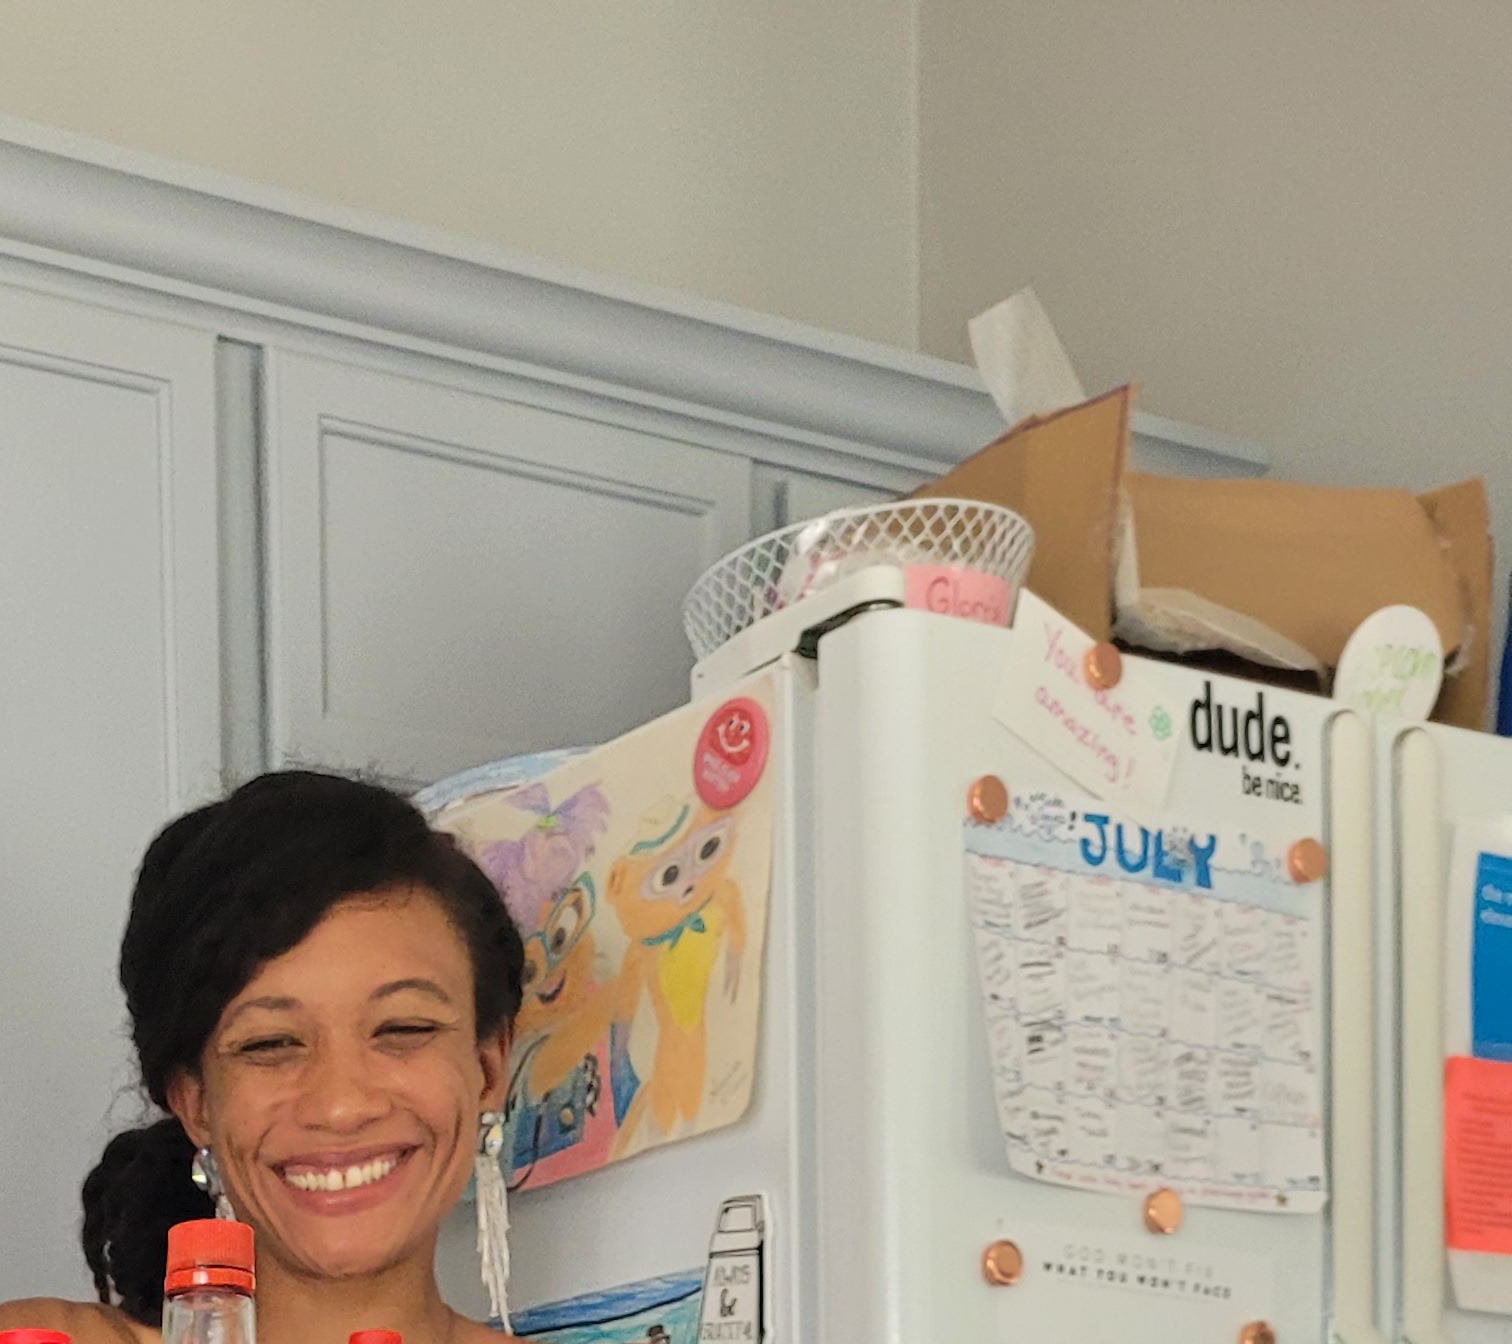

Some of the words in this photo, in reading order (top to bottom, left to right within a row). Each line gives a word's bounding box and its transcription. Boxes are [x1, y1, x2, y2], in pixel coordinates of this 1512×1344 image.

[1043, 624, 1083, 686] You
[1190, 680, 1302, 770] dude.
[1242, 766, 1262, 797] be
[1080, 812, 1218, 890] JULY
